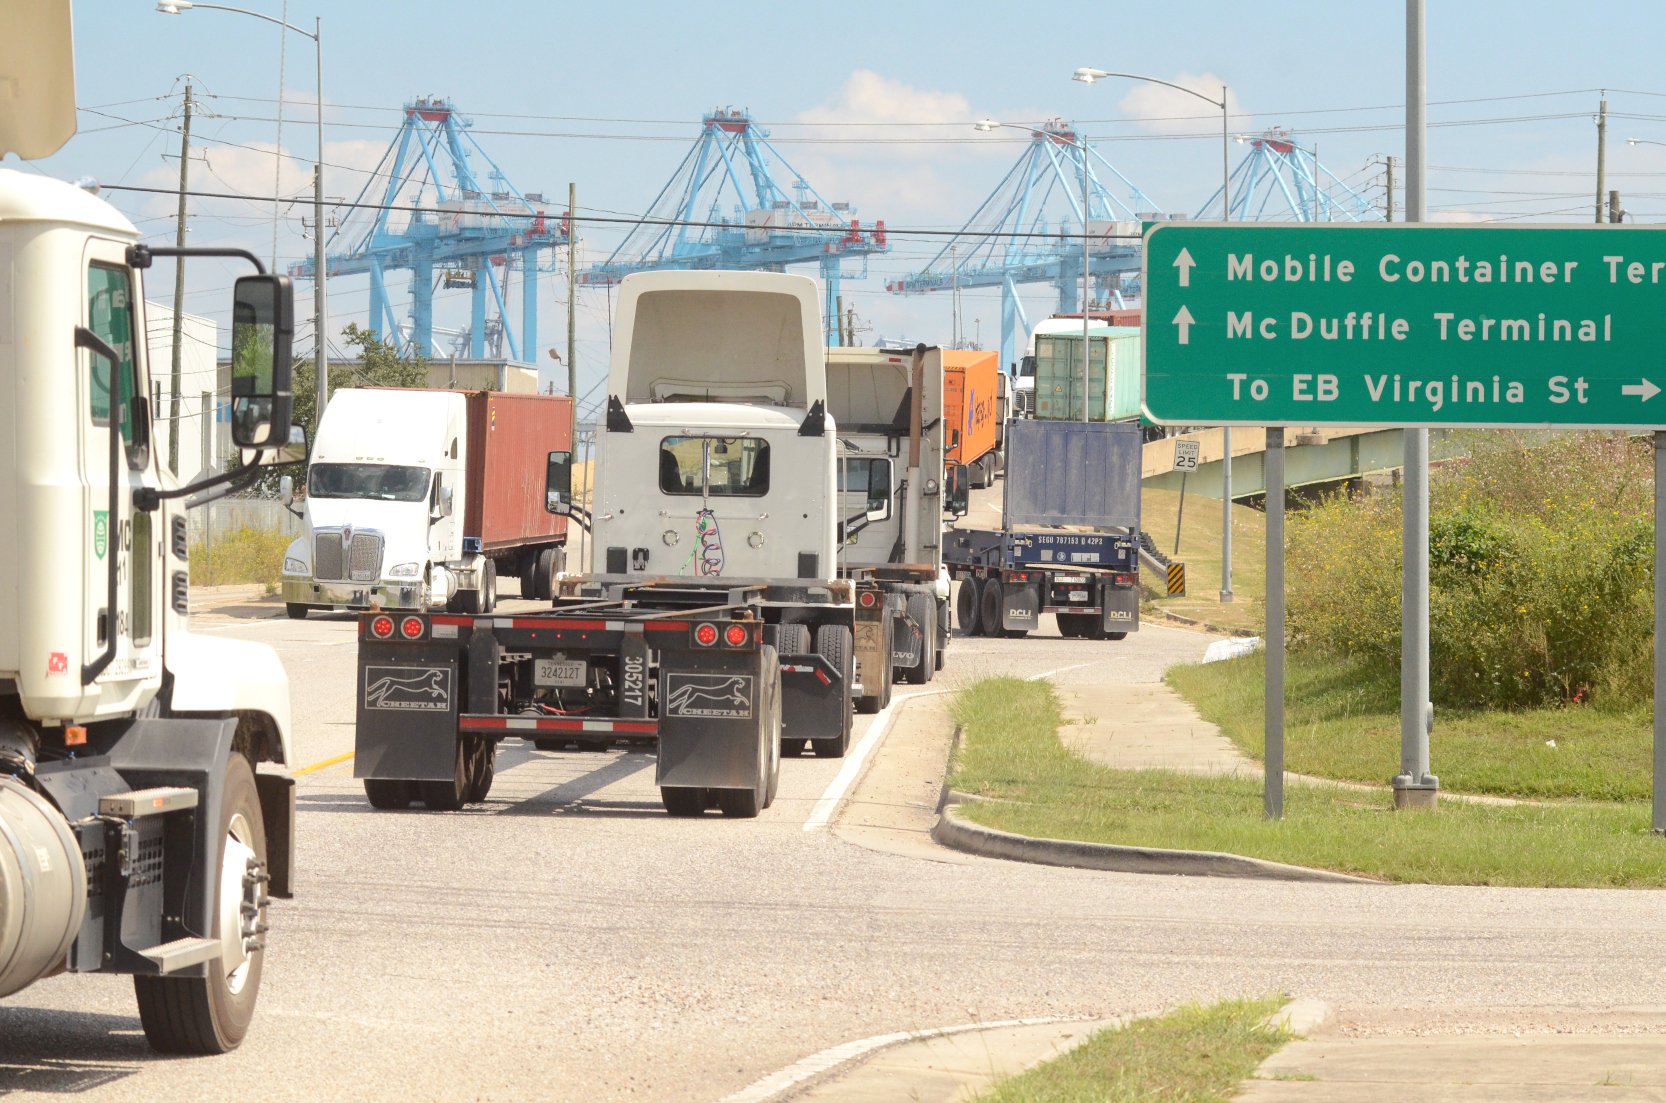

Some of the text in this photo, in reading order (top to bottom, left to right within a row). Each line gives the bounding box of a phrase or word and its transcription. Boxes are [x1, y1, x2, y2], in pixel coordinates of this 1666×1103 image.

[1227, 253, 1666, 284] Mobile Container Ter
[1227, 311, 1277, 340] Mc
[1434, 313, 1611, 341] Terminal
[1227, 373, 1589, 412] To EB Virginia St
[1176, 456, 1196, 468] 25
[1038, 536, 1054, 544] SEGU
[1087, 537, 1103, 545] 42P3
[541, 666, 580, 679] 324212T
[624, 656, 643, 706] 305217
[381, 701, 448, 709] CHEETAH
[682, 708, 750, 717] CHEETAH
